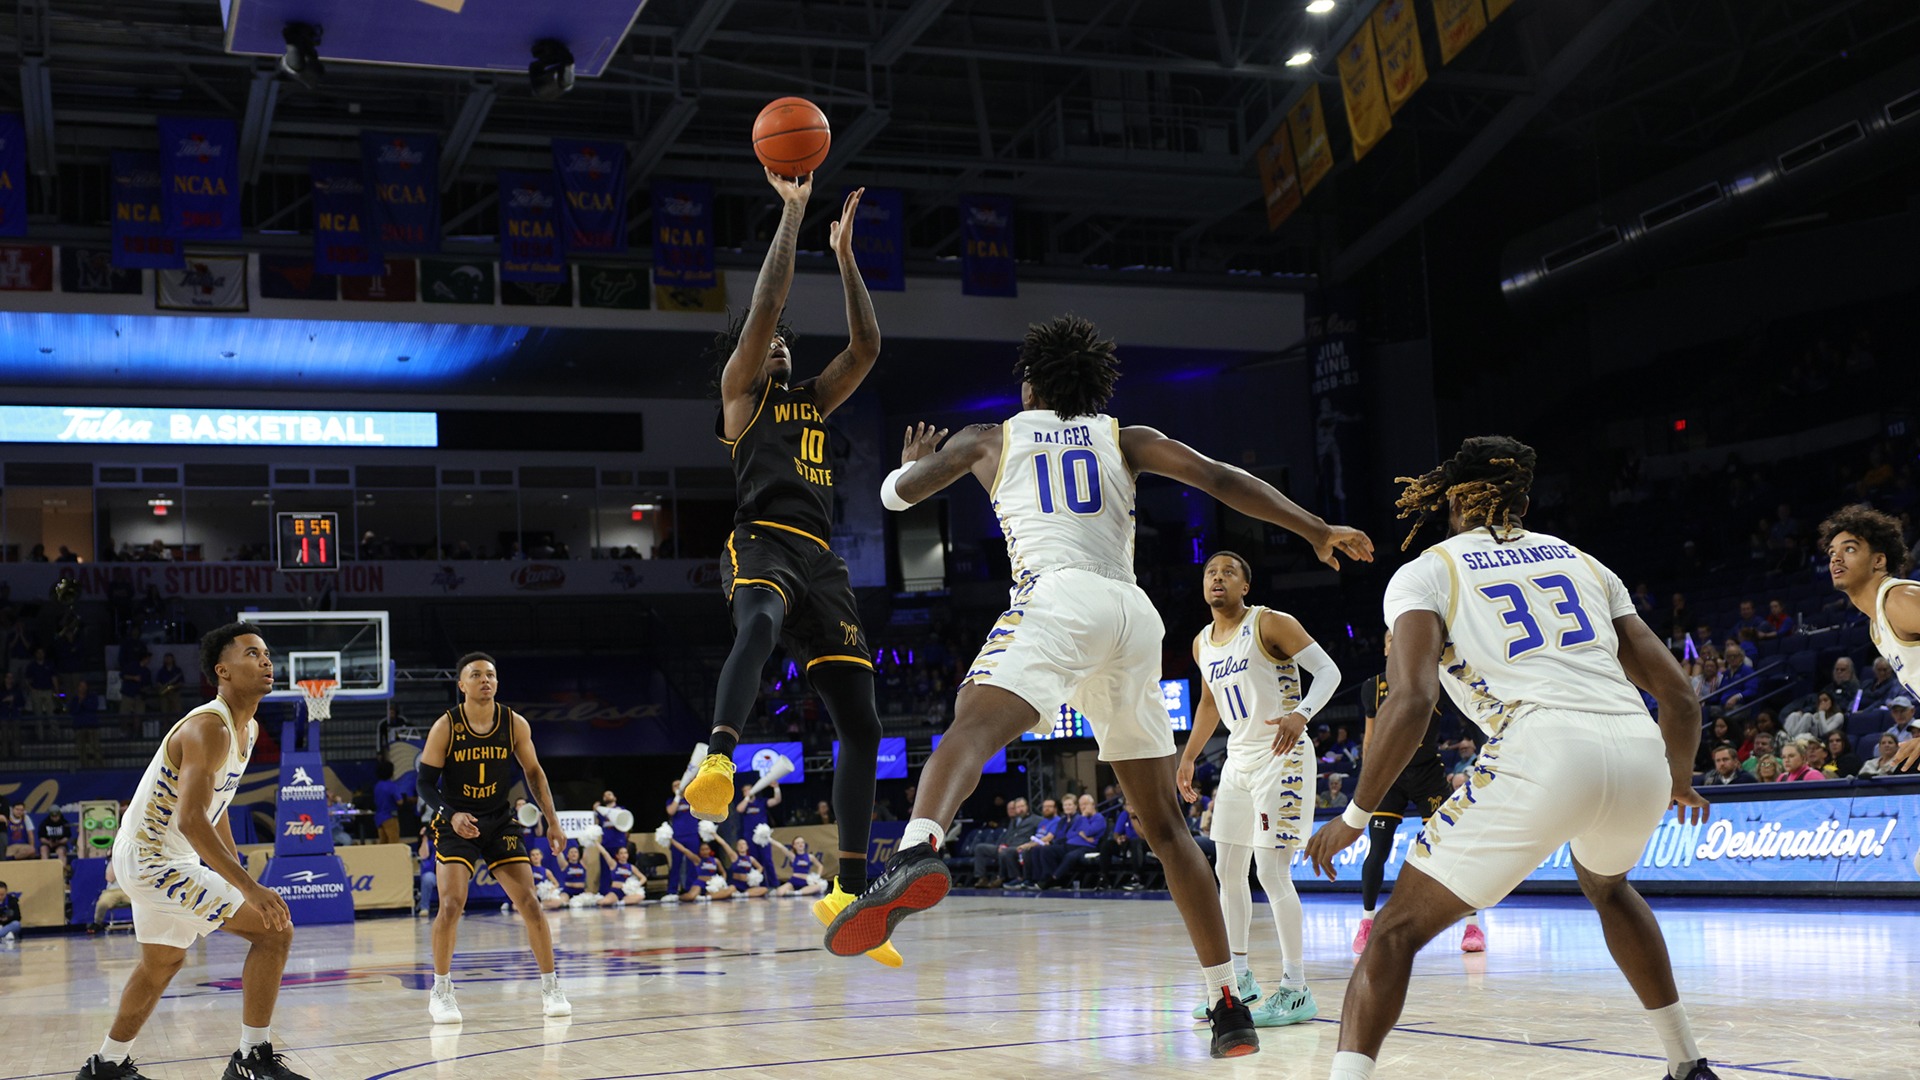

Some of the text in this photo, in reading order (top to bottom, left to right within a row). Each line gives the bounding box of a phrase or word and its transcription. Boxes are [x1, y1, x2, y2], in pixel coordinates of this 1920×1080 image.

[174, 175, 228, 195] NCAA
[376, 183, 427, 204] NCAA
[566, 190, 615, 211] NCAA
[116, 202, 162, 222] NCA
[319, 212, 360, 232] NCA
[508, 218, 555, 238] NCAA
[1317, 340, 1345, 361] JIM
[1315, 355, 1350, 378] KING
[57, 408, 384, 443] Tulsa BASKETBALL
[801, 427, 825, 464] 10
[794, 456, 833, 487] STATE
[1034, 449, 1102, 514] 10
[301, 537, 327, 564] 11
[1463, 544, 1576, 570] SELEBANGUE
[164, 566, 278, 594] STUDENT
[1479, 574, 1596, 659] 33
[1209, 656, 1249, 683] Tulsa
[1225, 685, 1248, 720] 11
[454, 746, 508, 762] WICHITA
[479, 763, 486, 784] 1
[463, 782, 498, 799] STATE
[284, 821, 325, 836] Tulsa
[560, 818, 593, 832] EFENSE
[1696, 819, 1897, 860] Destination!
[292, 883, 344, 894] THORNTON
